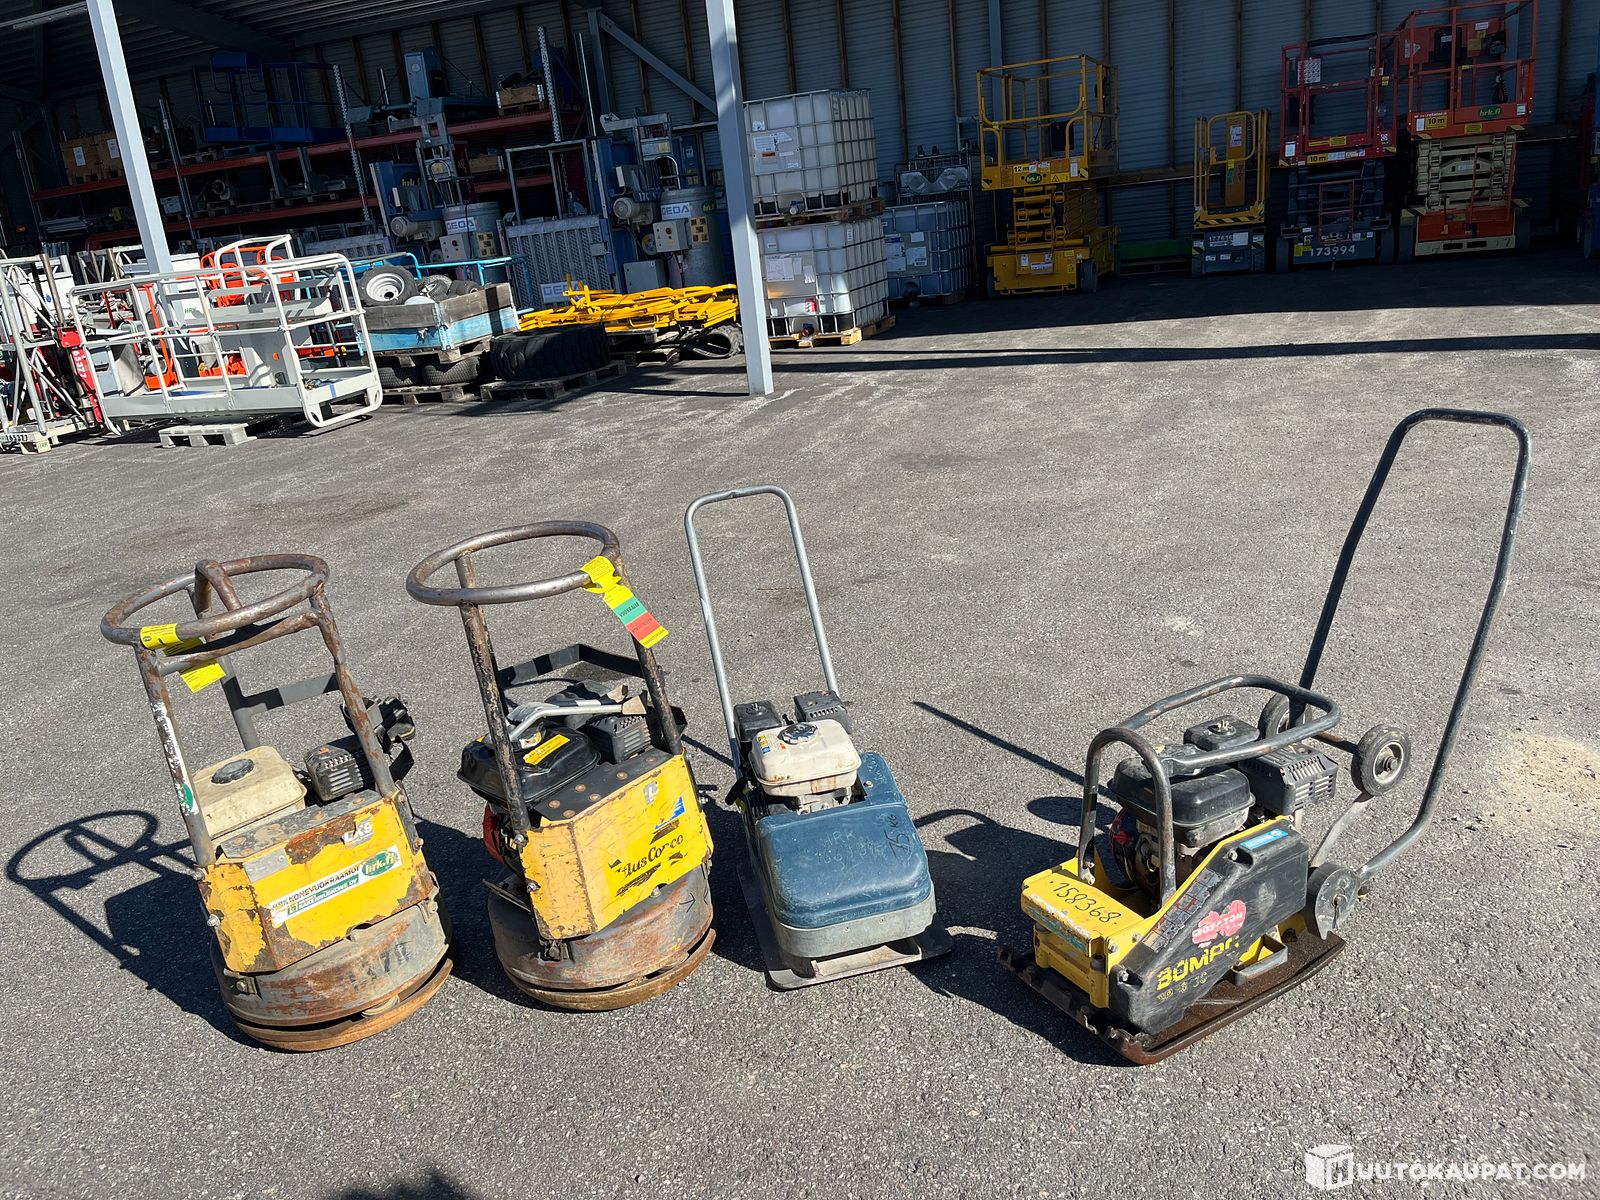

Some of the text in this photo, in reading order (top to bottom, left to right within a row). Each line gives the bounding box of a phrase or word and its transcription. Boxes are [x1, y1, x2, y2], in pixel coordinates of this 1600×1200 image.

[1428, 117, 1437, 125] 10
[661, 205, 690, 216] GEDA
[447, 220, 475, 232] GEDA
[1310, 244, 1356, 257] 173994
[365, 853, 398, 875] hrk.fi
